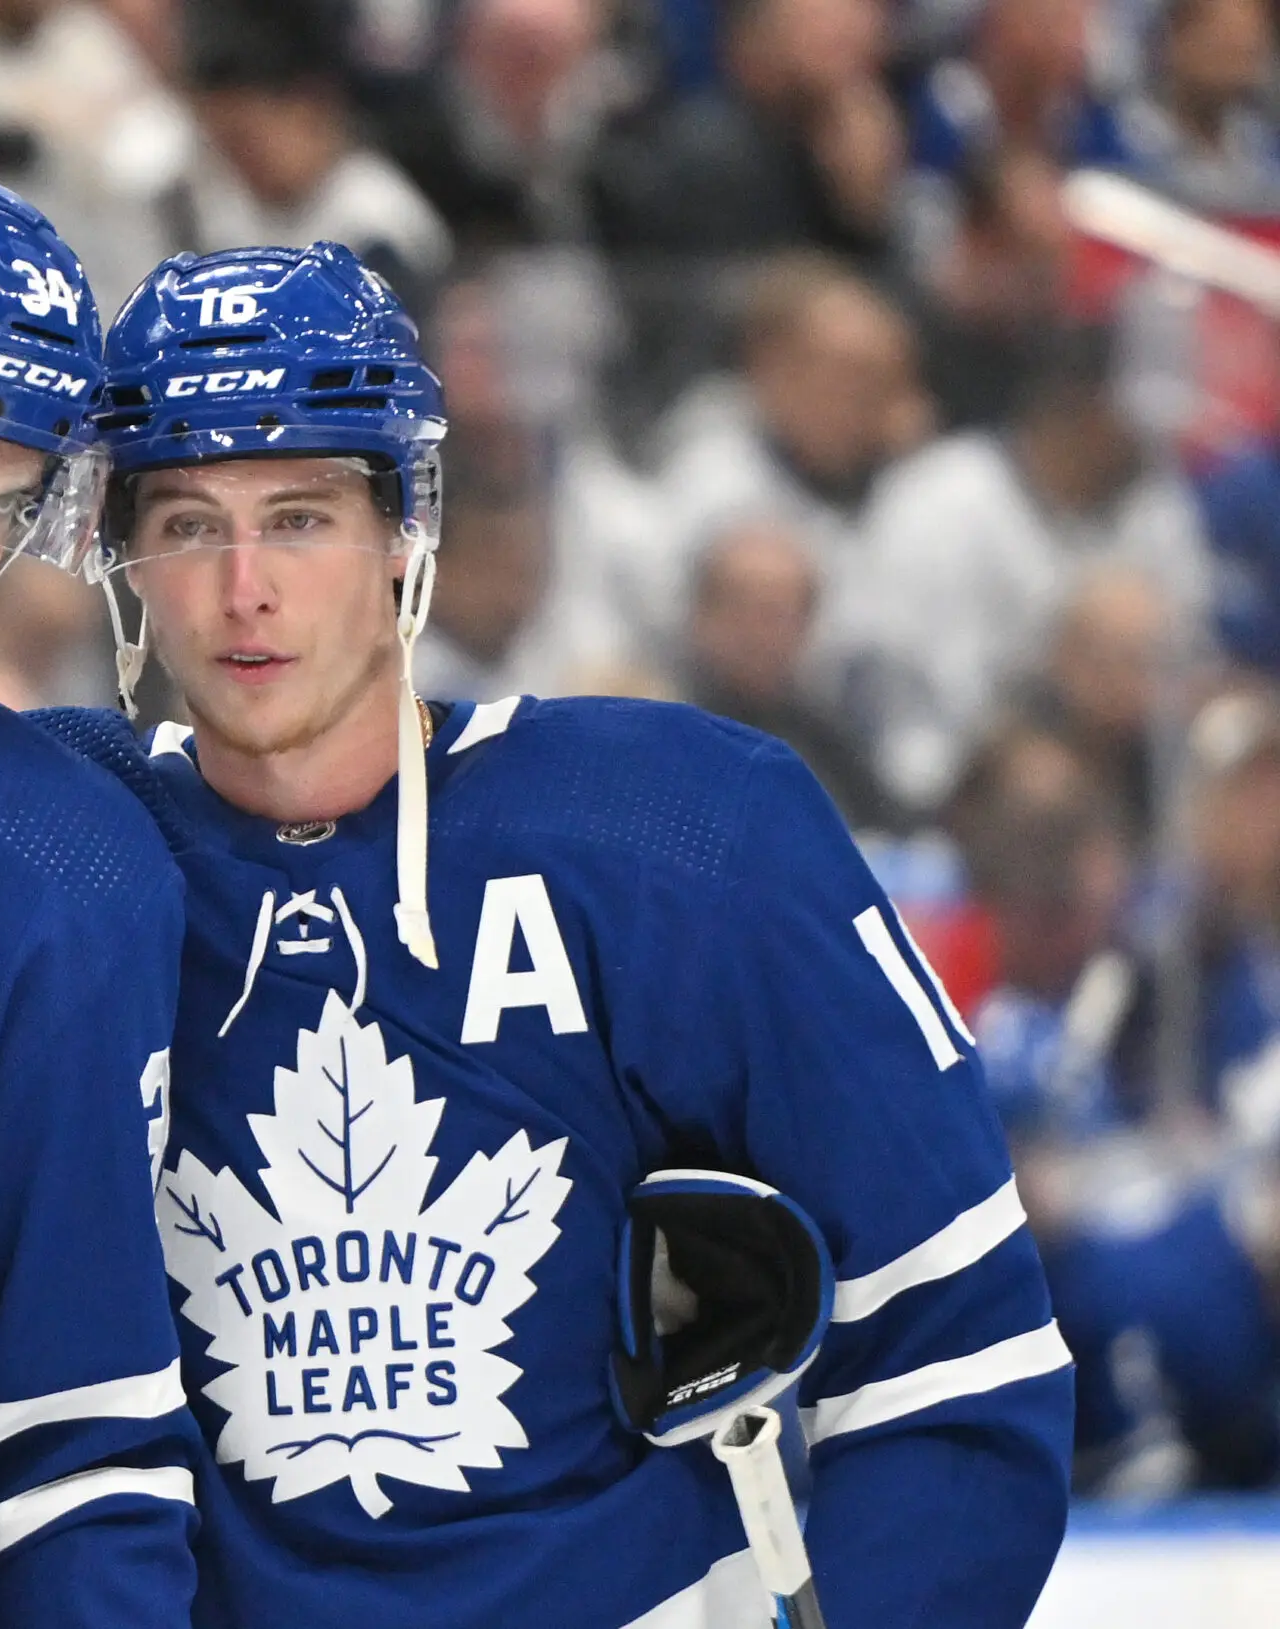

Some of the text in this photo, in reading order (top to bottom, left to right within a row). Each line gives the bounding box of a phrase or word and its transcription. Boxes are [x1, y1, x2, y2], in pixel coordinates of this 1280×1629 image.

[11, 258, 79, 327] 34
[199, 287, 258, 327] 16
[165, 368, 287, 397] CCM
[460, 873, 588, 1045] A
[851, 898, 976, 1072] 1
[216, 1230, 495, 1317] TORONTO
[263, 1302, 456, 1359] MAPLE
[266, 1360, 458, 1416] LEAFS
